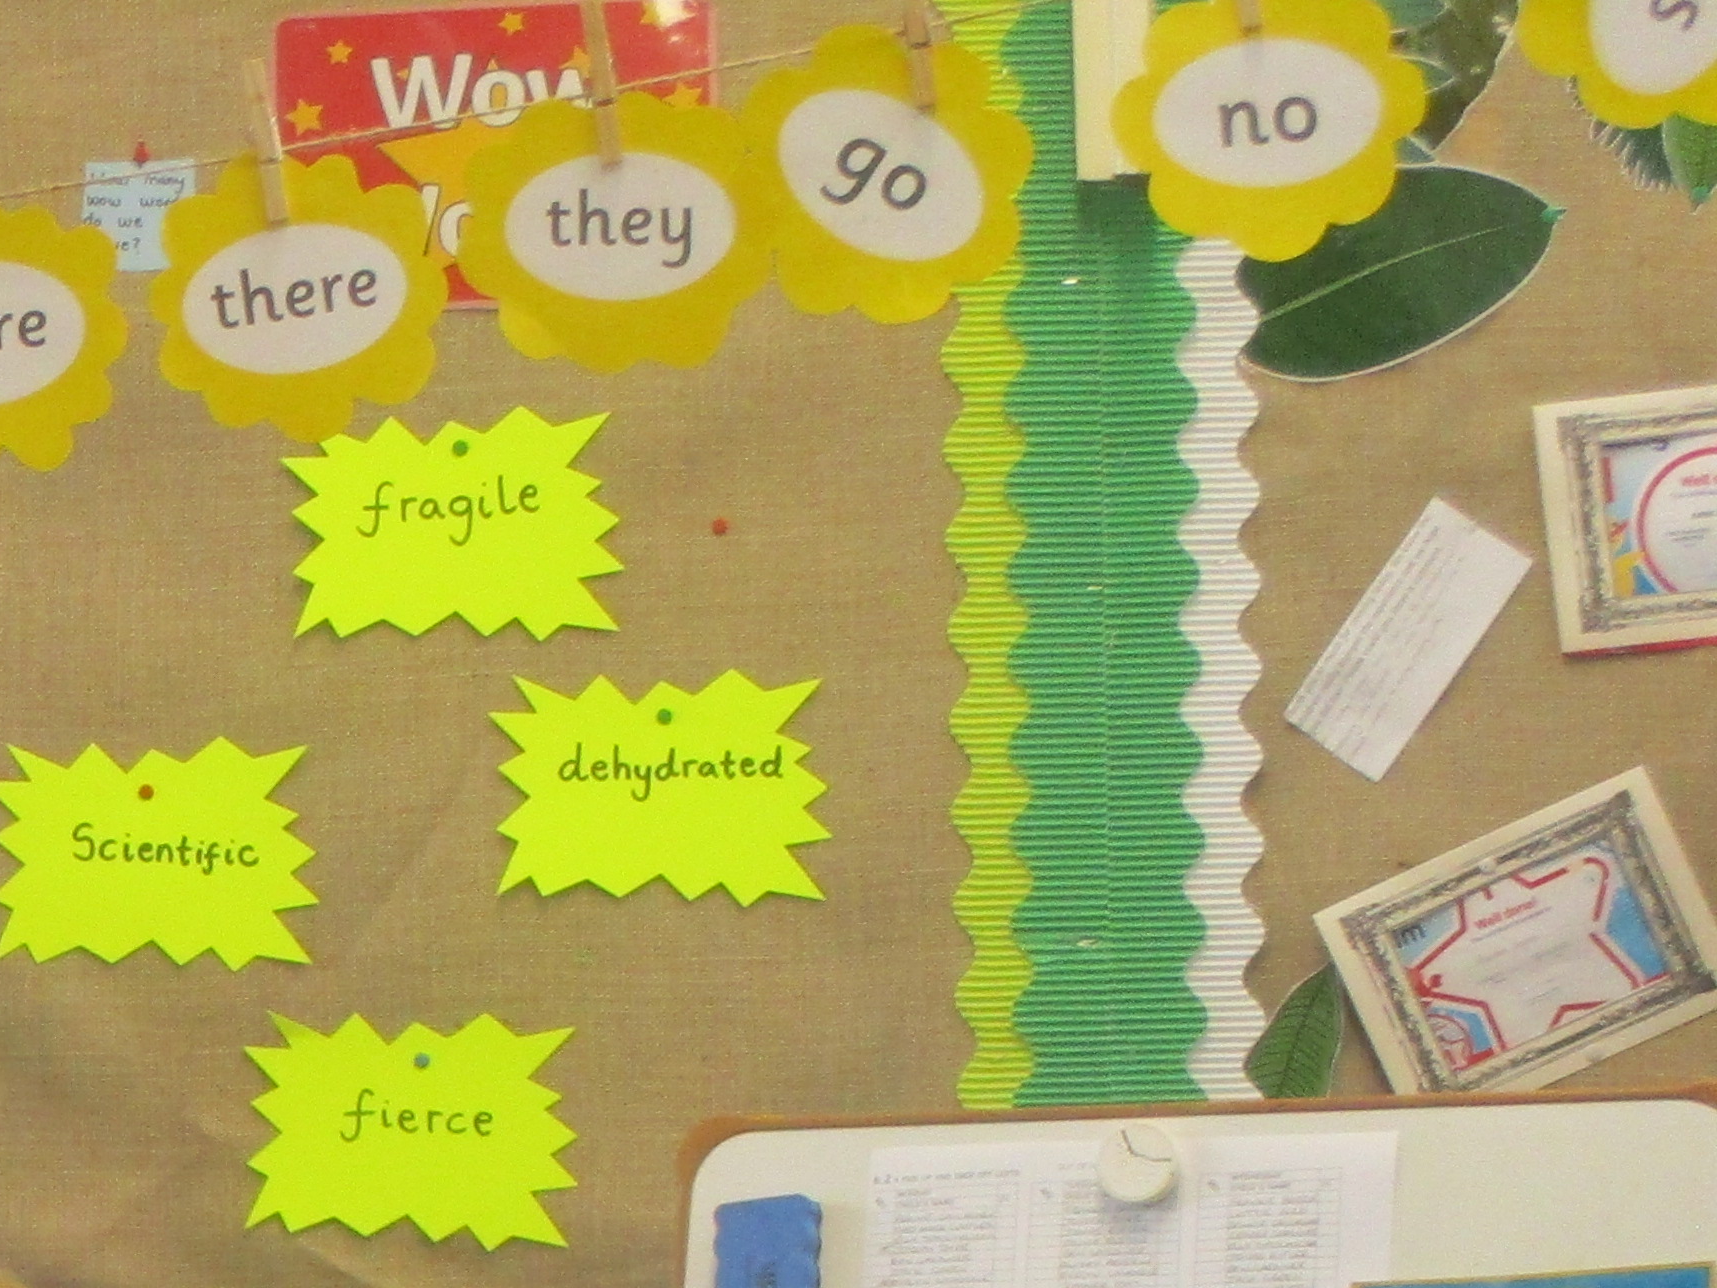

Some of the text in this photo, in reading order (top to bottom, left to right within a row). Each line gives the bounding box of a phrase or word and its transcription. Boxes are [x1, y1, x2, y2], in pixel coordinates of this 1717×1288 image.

[1217, 94, 1319, 149] no
[820, 135, 928, 211] go
[546, 188, 693, 269] they
[210, 267, 379, 330] there
[356, 475, 541, 546] fragile
[558, 743, 785, 802] dehydrated
[71, 822, 261, 876] Scientific
[339, 1086, 495, 1142] fierce
